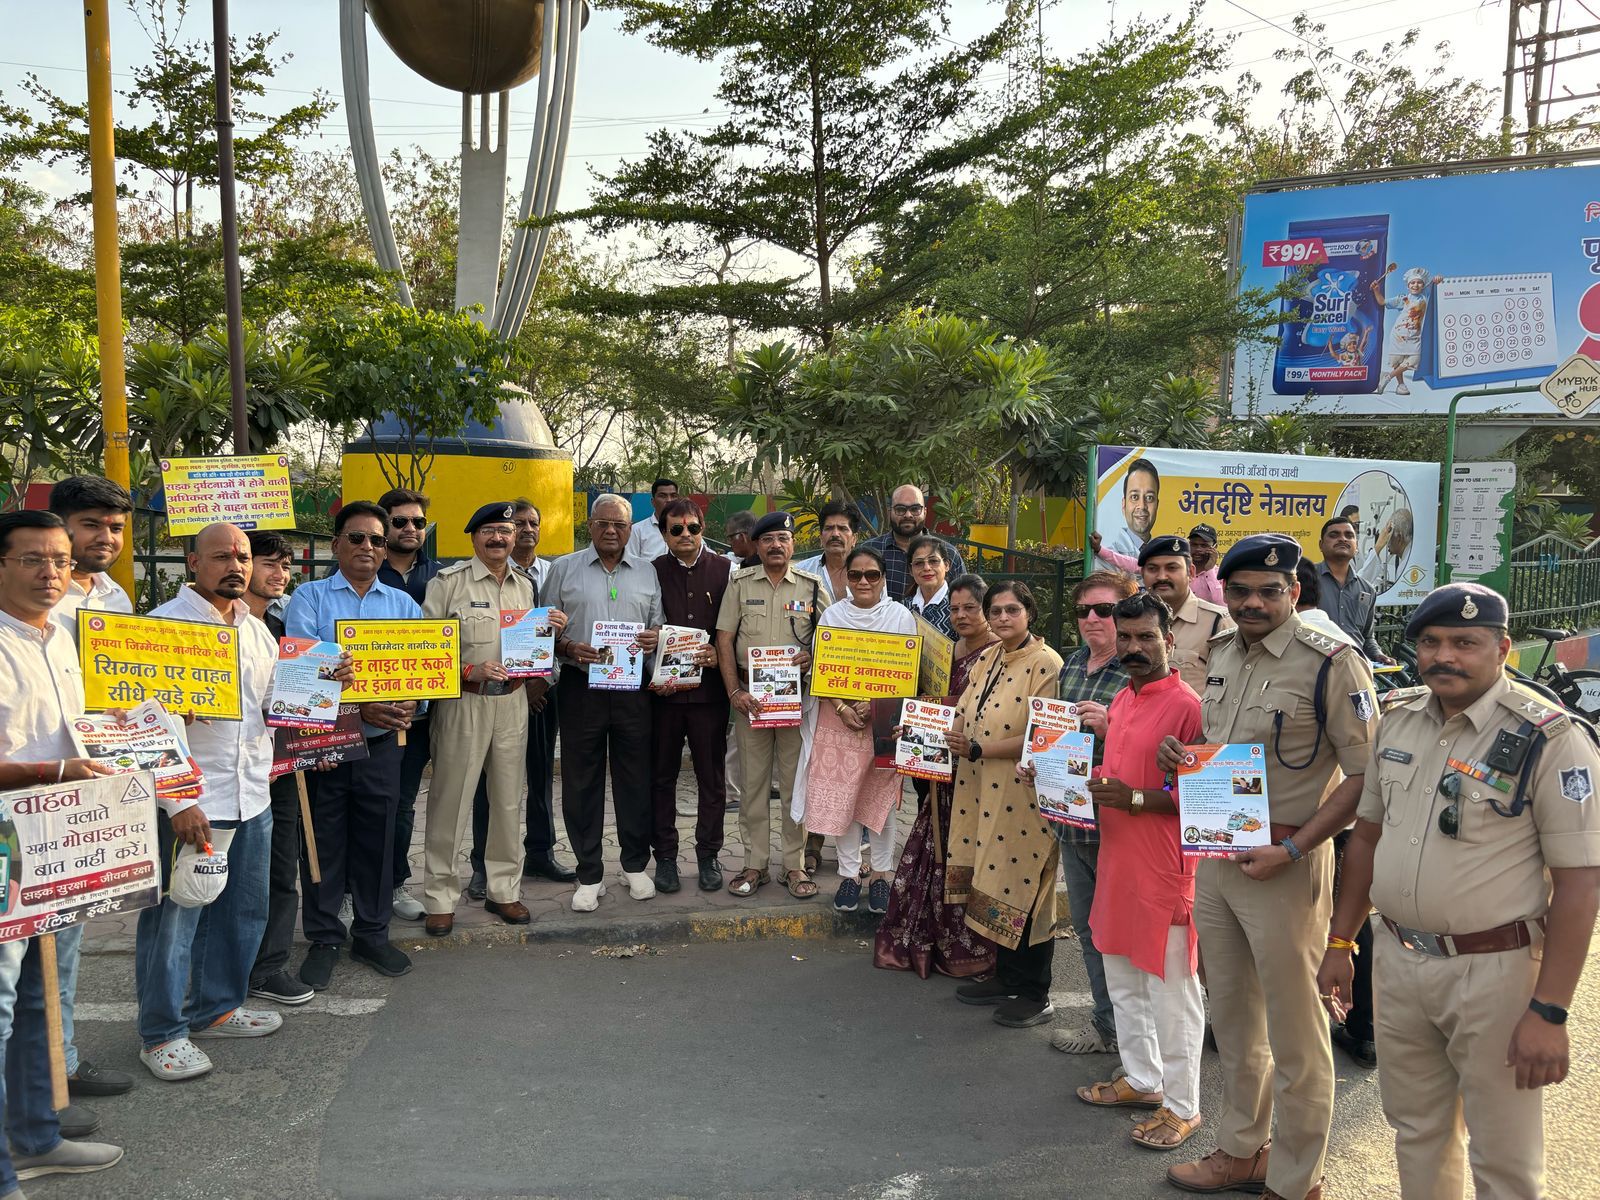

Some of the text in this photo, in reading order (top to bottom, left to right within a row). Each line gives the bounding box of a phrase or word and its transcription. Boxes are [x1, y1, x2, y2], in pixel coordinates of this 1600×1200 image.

[1268, 243, 1320, 262] ₹99/-
[1315, 293, 1352, 312] Surf
[1314, 310, 1347, 324] excel
[1311, 370, 1342, 378] MONTHLY
[1344, 369, 1363, 377] PACK
[1557, 377, 1598, 386] MYBYK
[503, 462, 514, 472] 60
[1220, 463, 1245, 476] आपकी
[1268, 467, 1280, 477] का
[1280, 466, 1299, 478] साथी
[249, 478, 265, 488] होने
[268, 477, 288, 486] वाली
[167, 493, 213, 502] अधिकतर
[1178, 482, 1327, 524] अंतर्दृष्टि नेत्रालय
[168, 504, 186, 514] तेज
[189, 503, 208, 514] गति
[212, 503, 220, 513] से
[224, 503, 248, 512] वाहन
[251, 502, 279, 510] चलाना
[619, 623, 634, 631] पीकर
[90, 637, 121, 651] कृपया
[125, 638, 169, 653] जिम्मेदार
[173, 645, 211, 657] नागरिक
[371, 640, 405, 651] जिम्मेदार
[407, 640, 438, 650] नागरिक
[94, 654, 232, 684] सिग्नल पर वाहन
[353, 652, 454, 674] ड लाइट पर रूकने
[818, 662, 913, 681] कृपया अनावश्यक
[352, 672, 449, 694] पर इंजन बंद करें.
[827, 676, 848, 689] हॉर्न
[852, 681, 861, 689] न
[108, 681, 221, 709] सीधे खड़े करें.
[920, 706, 940, 716] वाहन
[1047, 703, 1066, 714] वाहन
[103, 722, 140, 732] वाहन
[1057, 715, 1075, 725] मोबाइल
[292, 757, 317, 770] पुलिस
[12, 788, 82, 815] वाहन
[66, 804, 111, 825] चलाते
[26, 823, 147, 856] समय मोबाइल पर
[34, 841, 148, 877] बात नहीं करें।
[194, 865, 228, 874] OSTON
[56, 880, 89, 896] सुरक्षा
[100, 869, 130, 884] जीवन
[132, 864, 151, 875] रक्षा
[123, 883, 140, 891] पालन
[33, 911, 79, 933] पुलिस
[86, 899, 125, 918] इंदौर
